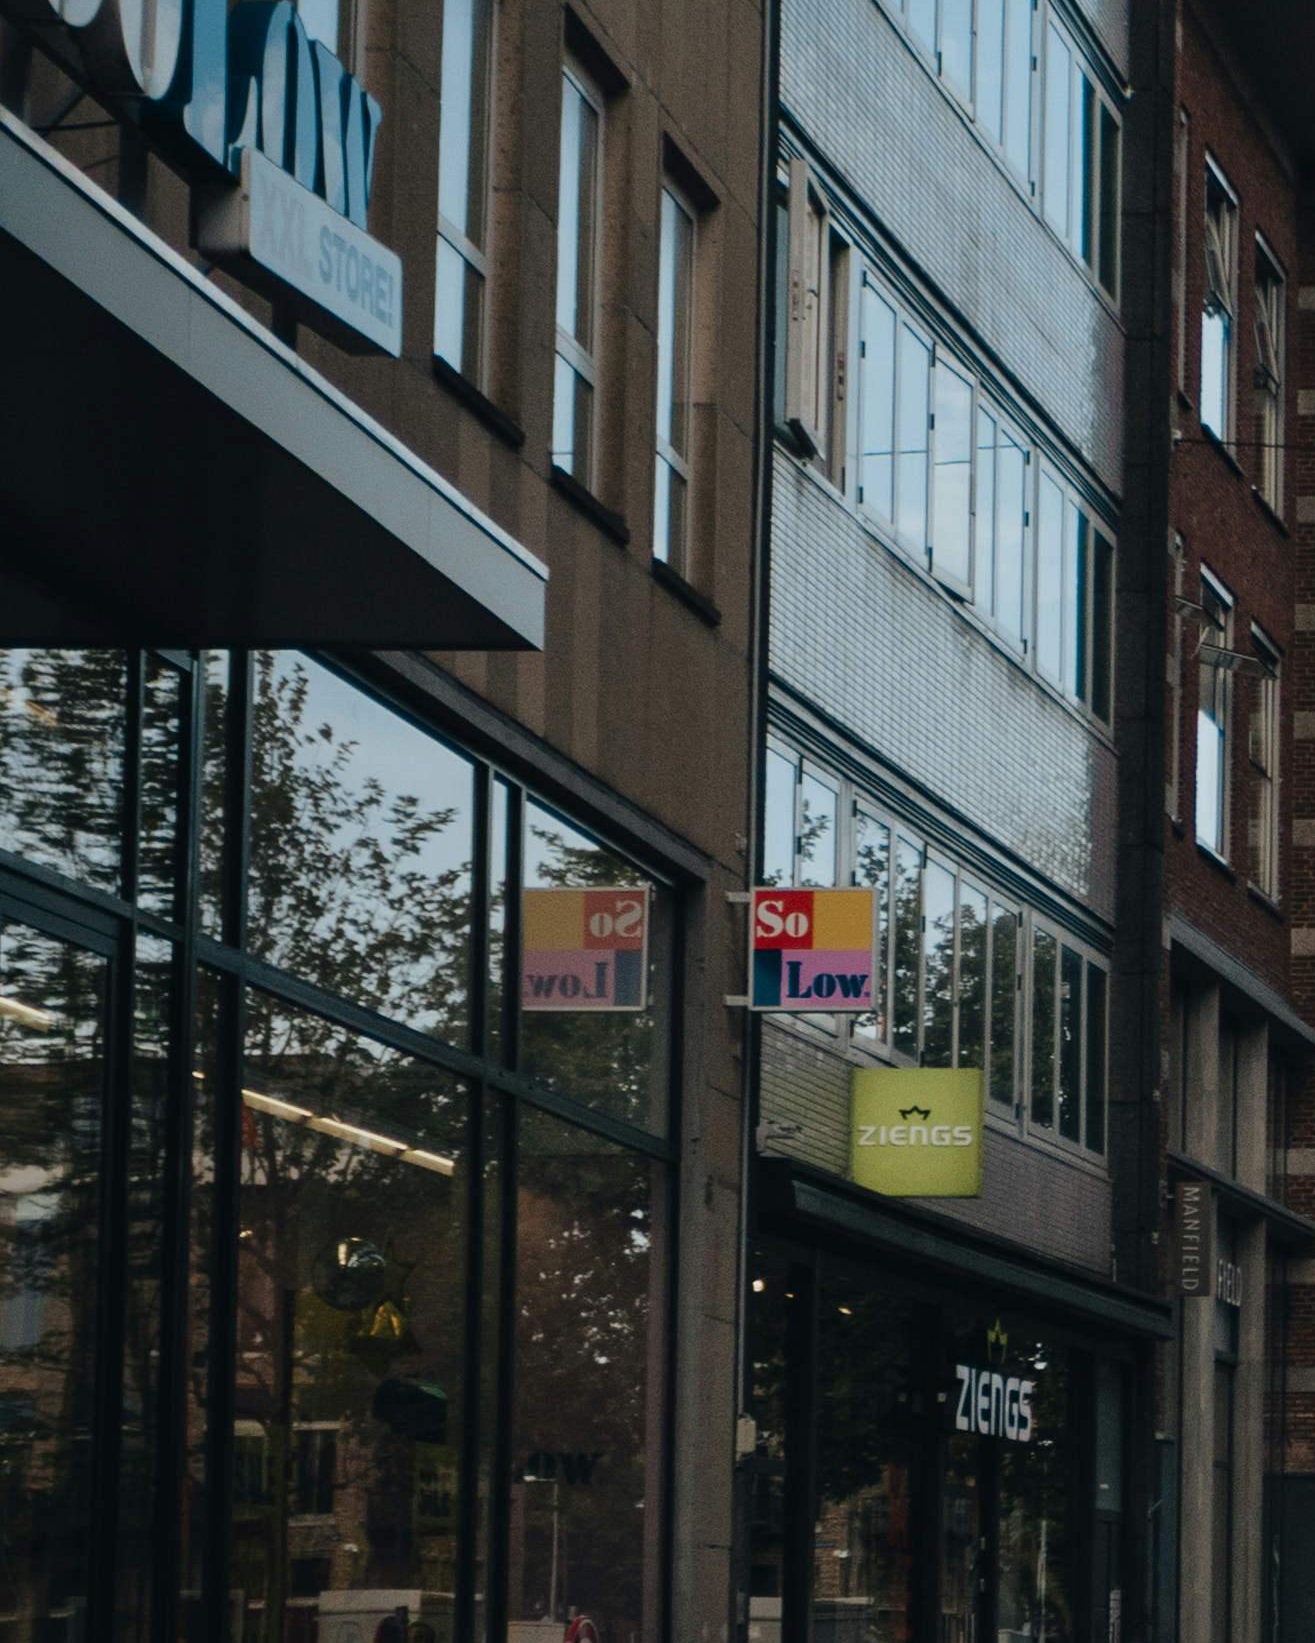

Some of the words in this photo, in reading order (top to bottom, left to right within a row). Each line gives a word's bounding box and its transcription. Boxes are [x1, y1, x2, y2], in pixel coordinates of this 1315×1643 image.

[258, 172, 314, 281] XXL
[319, 224, 394, 329] STORE!
[755, 899, 809, 938] So
[857, 1124, 973, 1147] ZIENGS
[1181, 1186, 1199, 1291] MANFIELD
[955, 1364, 1034, 1443] ZIENGS
